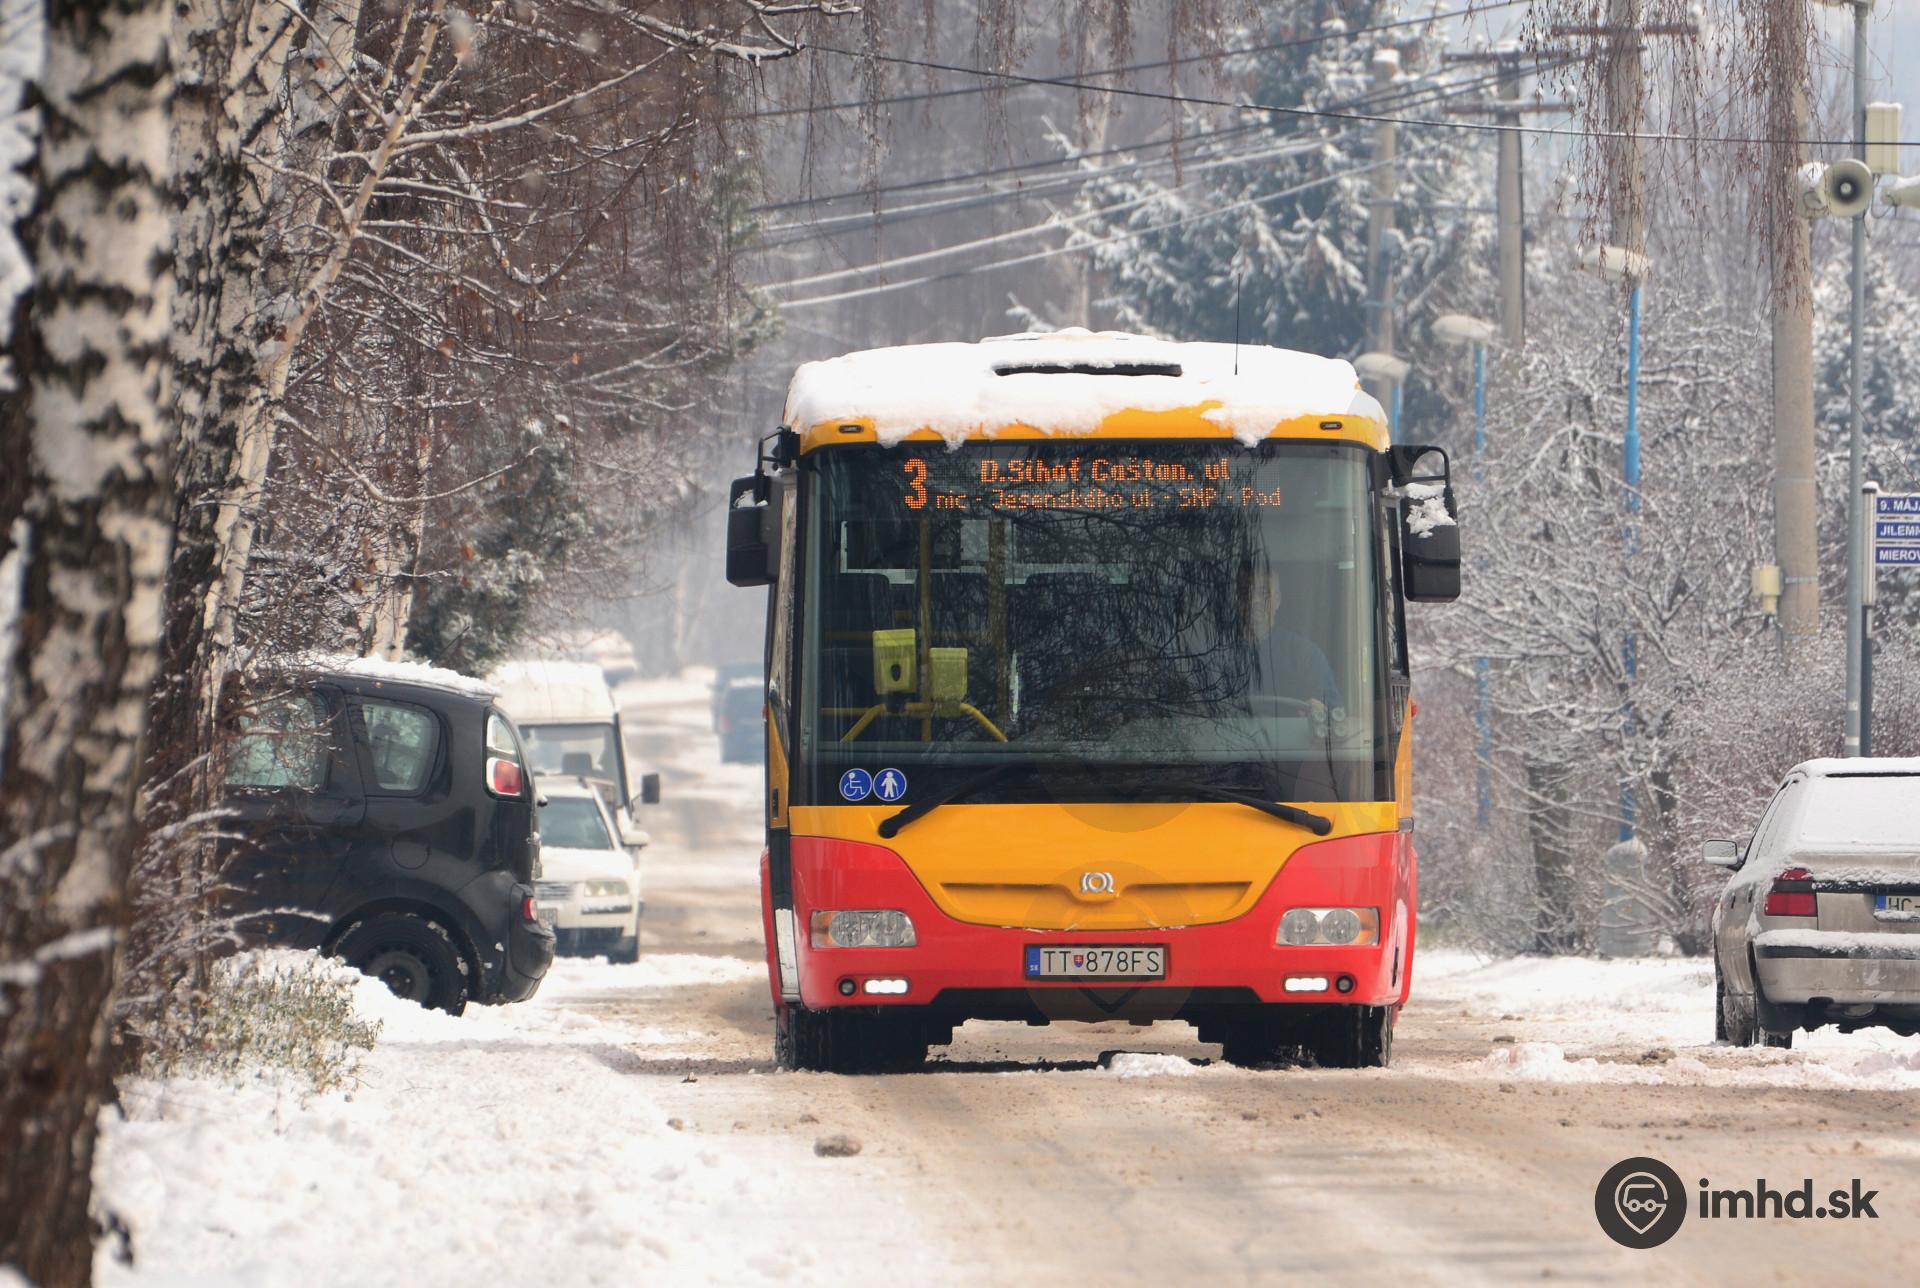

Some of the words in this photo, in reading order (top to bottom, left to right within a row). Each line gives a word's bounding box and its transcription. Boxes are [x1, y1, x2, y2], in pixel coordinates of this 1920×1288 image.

[1205, 457, 1231, 481] ul
[903, 458, 927, 509] 3
[1242, 487, 1281, 507] Pod
[1893, 498, 1920, 512] MÁJ
